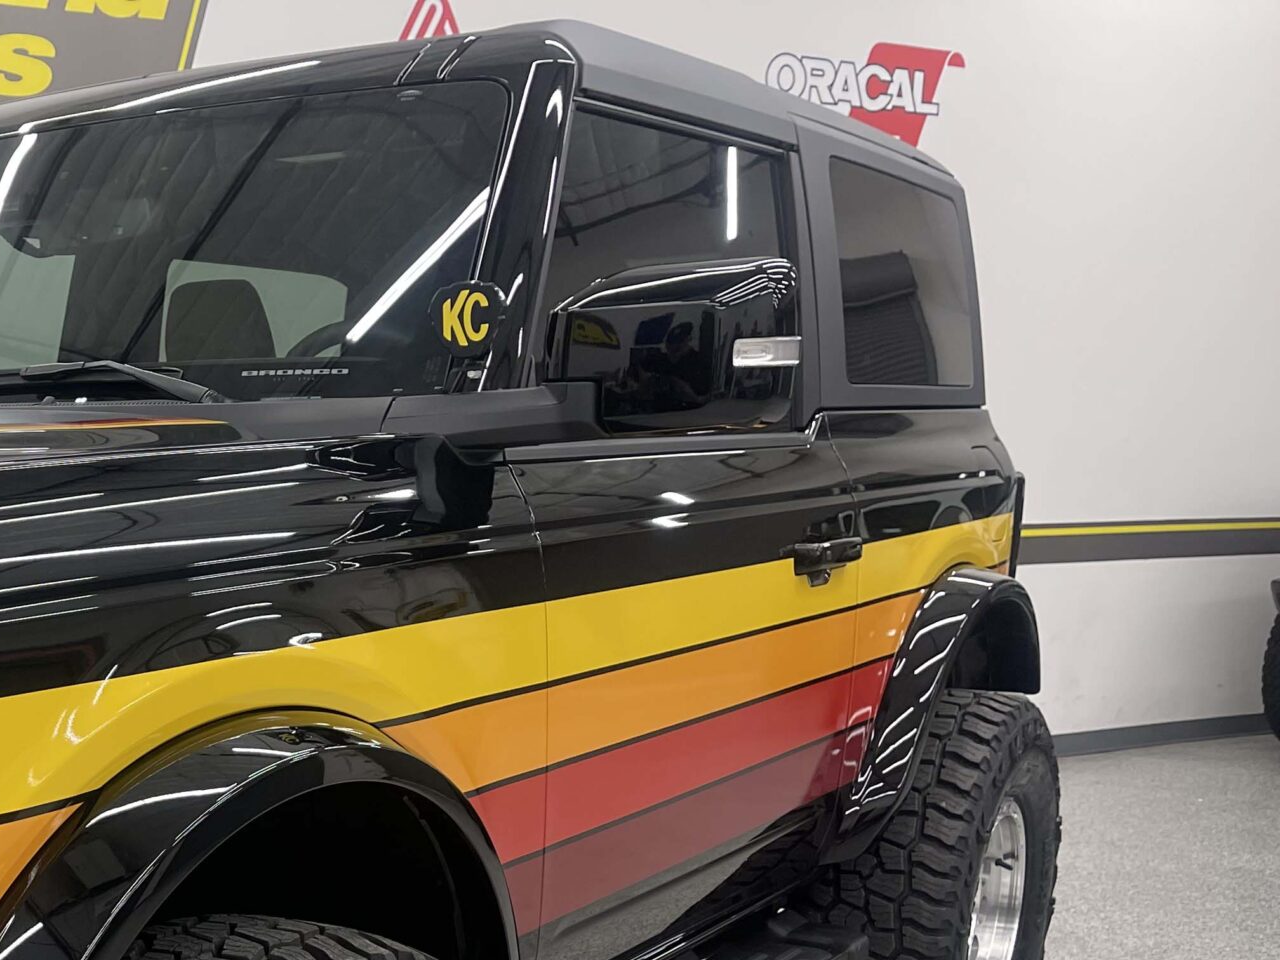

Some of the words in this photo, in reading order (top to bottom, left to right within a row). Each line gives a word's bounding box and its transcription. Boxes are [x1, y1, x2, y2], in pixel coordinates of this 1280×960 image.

[765, 52, 940, 117] ORACAL
[441, 289, 490, 346] KC
[240, 367, 350, 378] BRONCO
